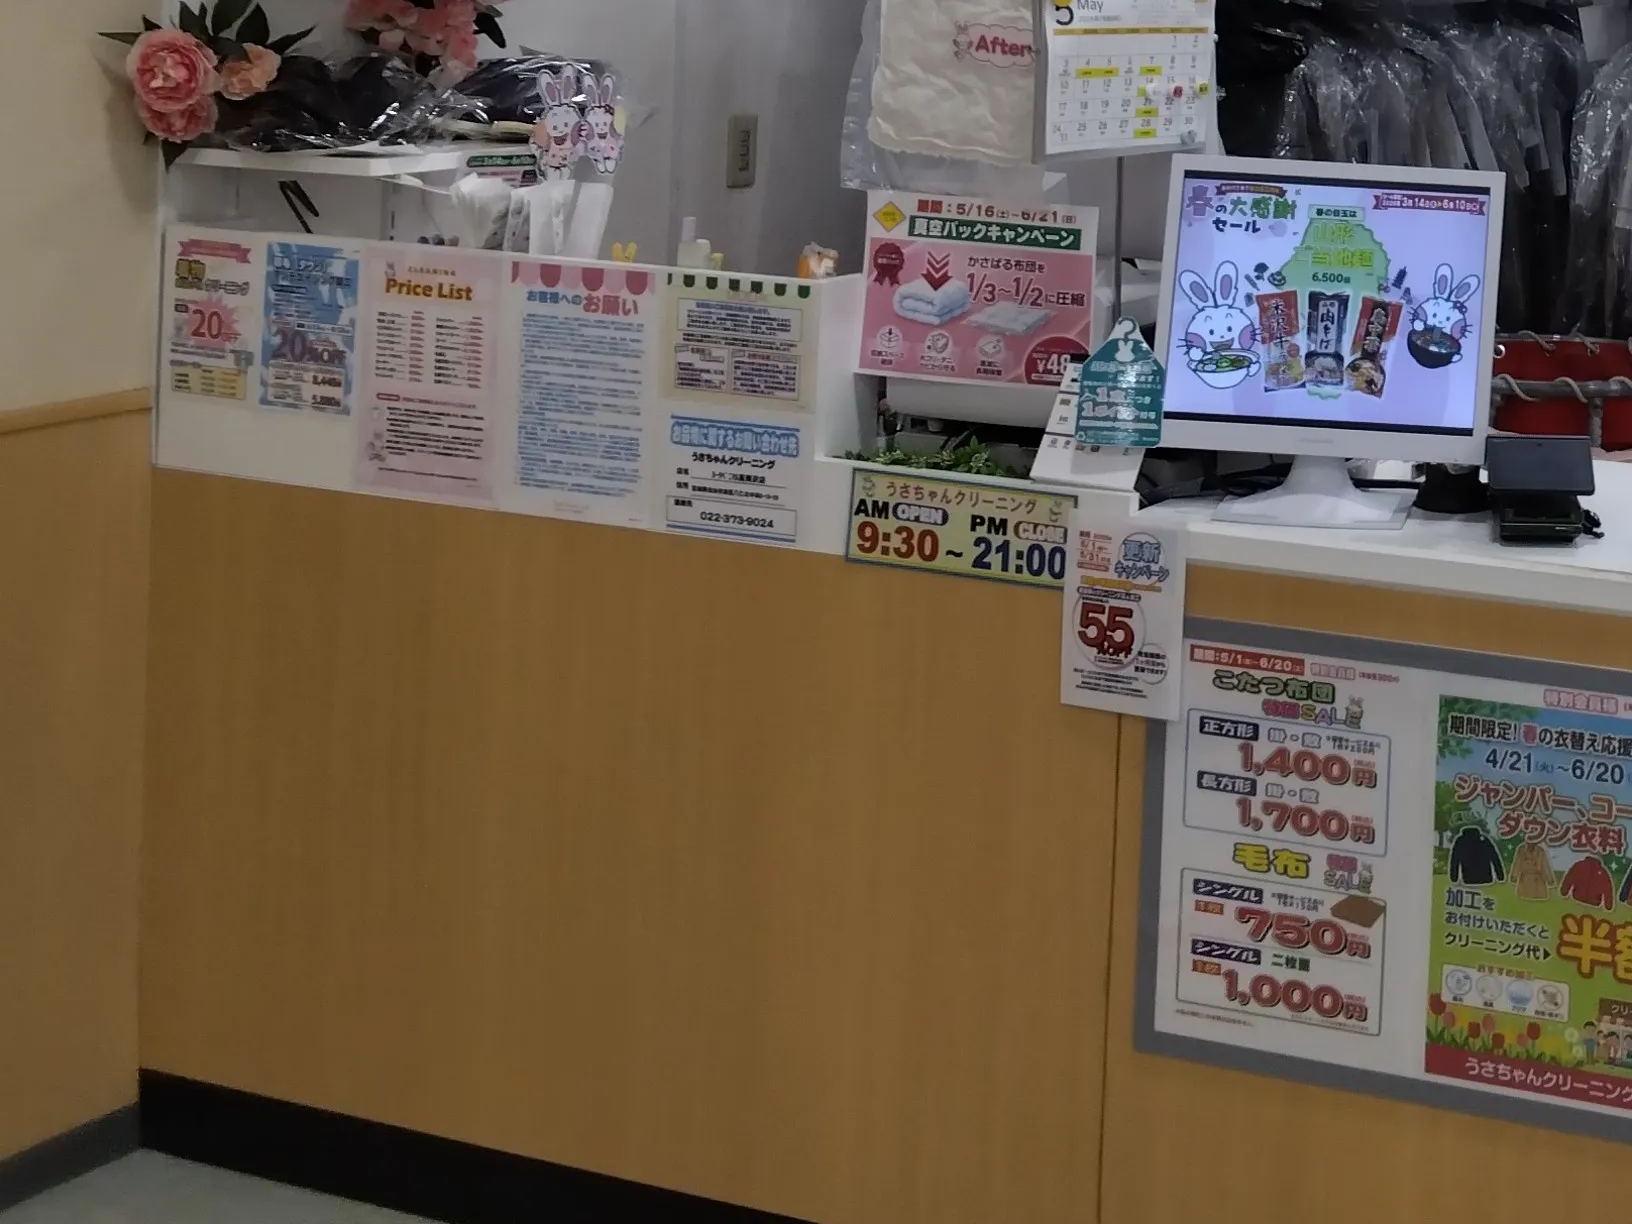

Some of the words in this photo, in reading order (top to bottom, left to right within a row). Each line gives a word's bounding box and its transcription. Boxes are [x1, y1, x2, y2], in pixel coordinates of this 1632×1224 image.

[975, 34, 1030, 58] After
[1186, 185, 1297, 220] 春の大感謝
[1315, 208, 1358, 218] 春の目玉は
[912, 216, 1076, 248] 真空パックキャンペーン
[1212, 217, 1261, 233] セール
[1313, 223, 1355, 245] 山形
[408, 266, 456, 276] CLEANING
[967, 255, 1046, 274] かさばる布団を
[385, 278, 433, 298] Price
[437, 283, 473, 301] List
[526, 290, 639, 316] お客様へのお願い
[1320, 309, 1336, 351] 肉そば
[692, 452, 775, 470] うさちゃんクリーニング
[886, 481, 1037, 514] うさちゃんクリーニング
[700, 511, 774, 529] 022-373-9024
[854, 498, 890, 520] AM
[896, 505, 945, 525] OPEN
[970, 514, 1009, 536] PM
[1017, 521, 1067, 543] CLOSE
[856, 521, 939, 562] 9:30
[971, 537, 1067, 579] 21:00
[1122, 539, 1161, 564] 更新
[1114, 561, 1171, 582] キャンペーン
[1213, 669, 1336, 704] こたつ布団
[1543, 689, 1619, 714] 特別会員様
[1203, 719, 1254, 737] 正方形
[1450, 714, 1519, 742] 期間限定!
[1238, 741, 1378, 789] 1,400円
[1200, 774, 1253, 793] 長方形
[1236, 797, 1375, 844] 1,700円
[1498, 811, 1625, 855] ダウン衣料
[1233, 842, 1311, 879] 毛布
[1196, 879, 1262, 903] シングル
[1324, 870, 1374, 894] SALE
[1446, 888, 1495, 912] 加工を
[1234, 906, 1371, 959] 750円
[1445, 911, 1550, 940] お付けいただくと
[1194, 940, 1259, 964] シングル
[1444, 932, 1541, 961] クリーニング代
[1222, 968, 1368, 1022] 1,000円
